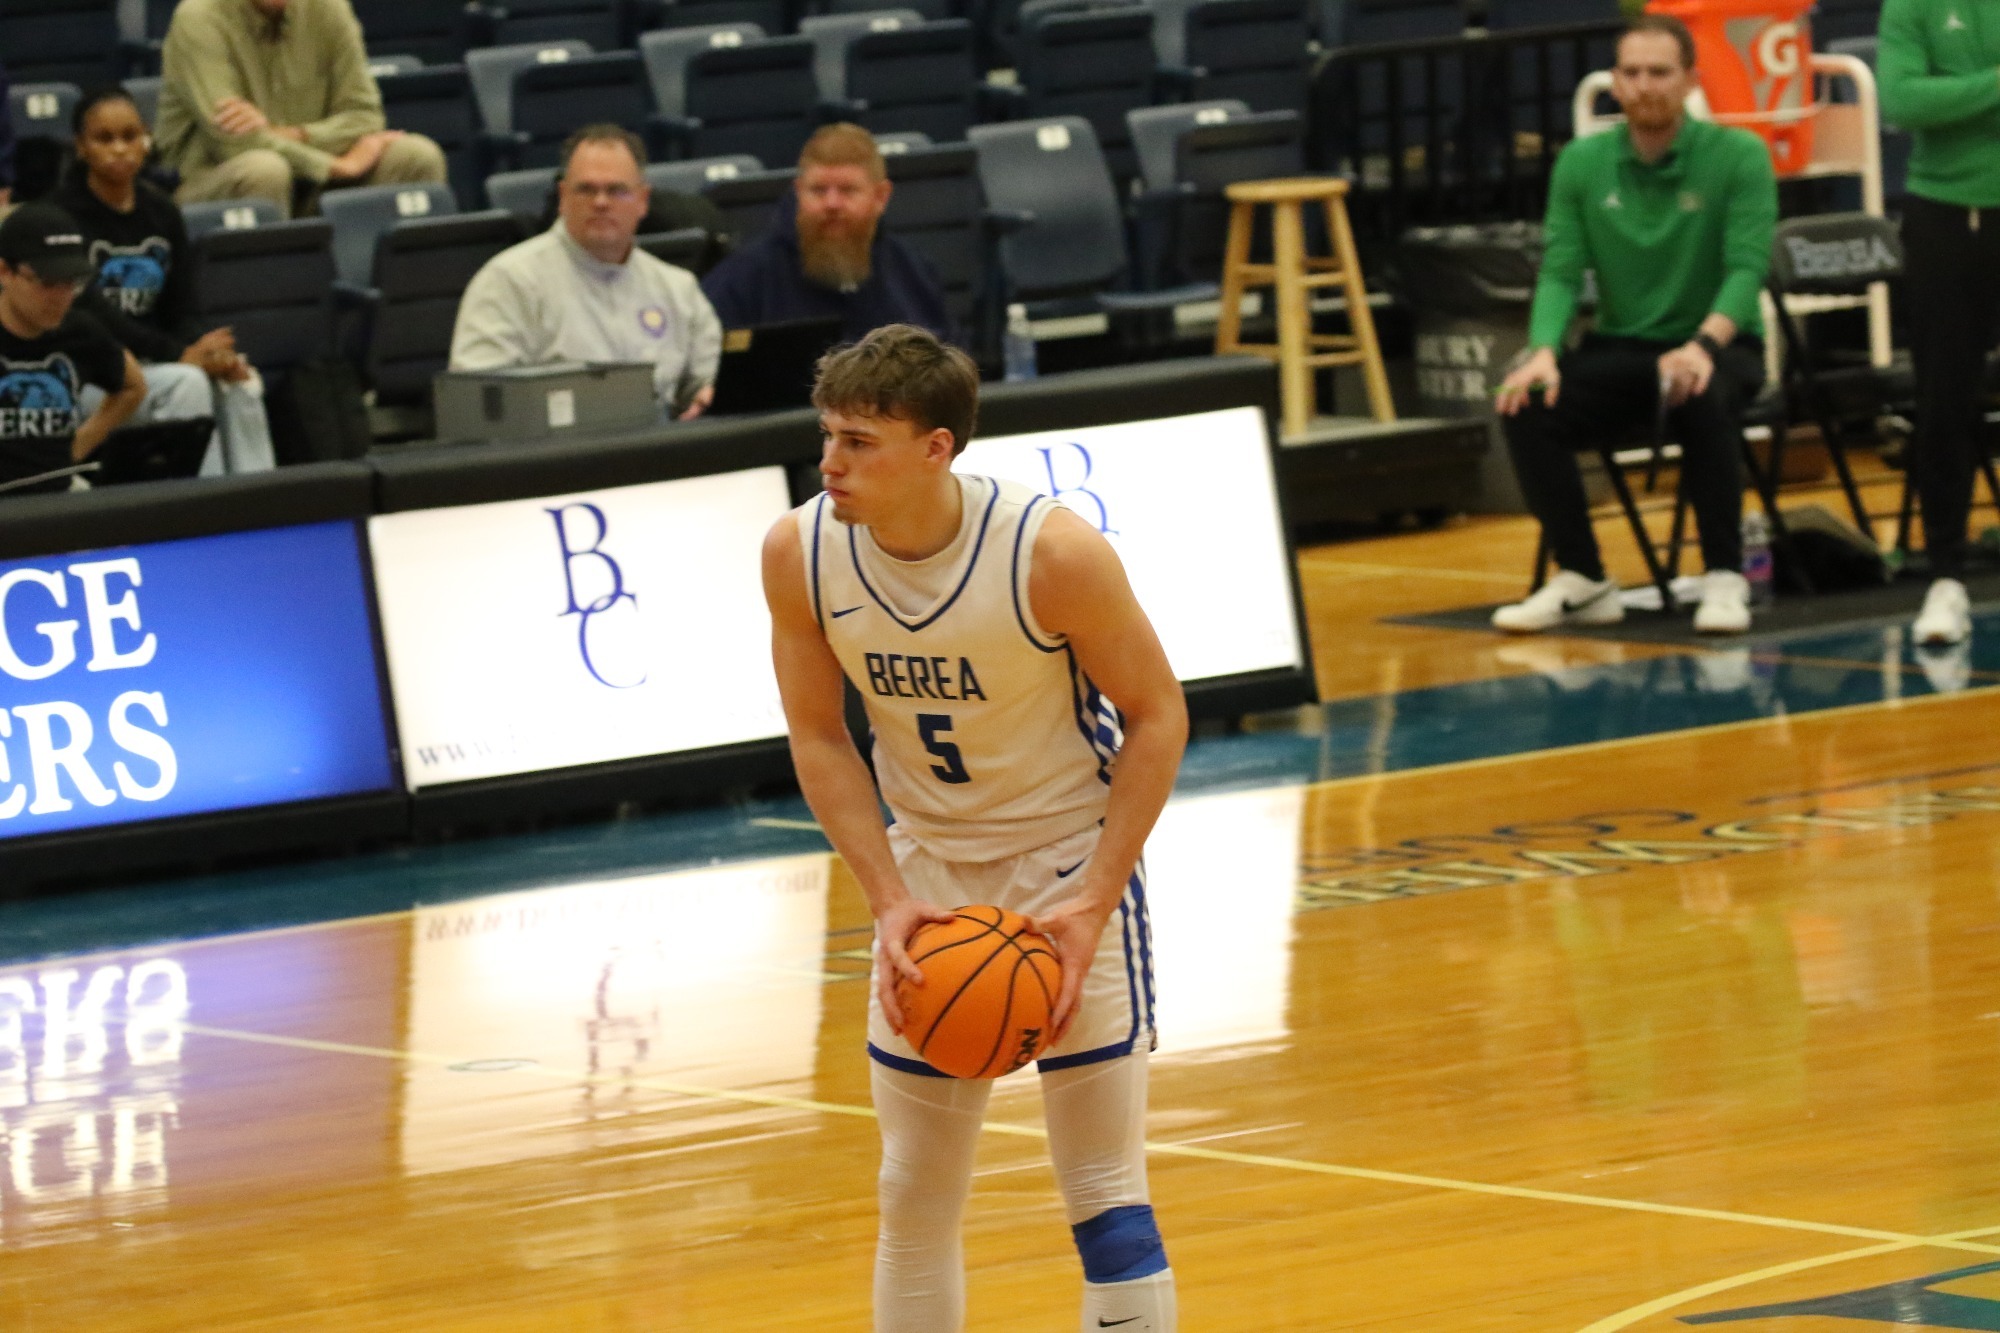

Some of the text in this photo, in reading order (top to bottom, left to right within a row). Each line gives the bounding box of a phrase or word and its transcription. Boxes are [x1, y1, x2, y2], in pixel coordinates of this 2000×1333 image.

[1759, 22, 1798, 76] G
[864, 652, 988, 701] BEREA
[916, 713, 972, 785] 5
